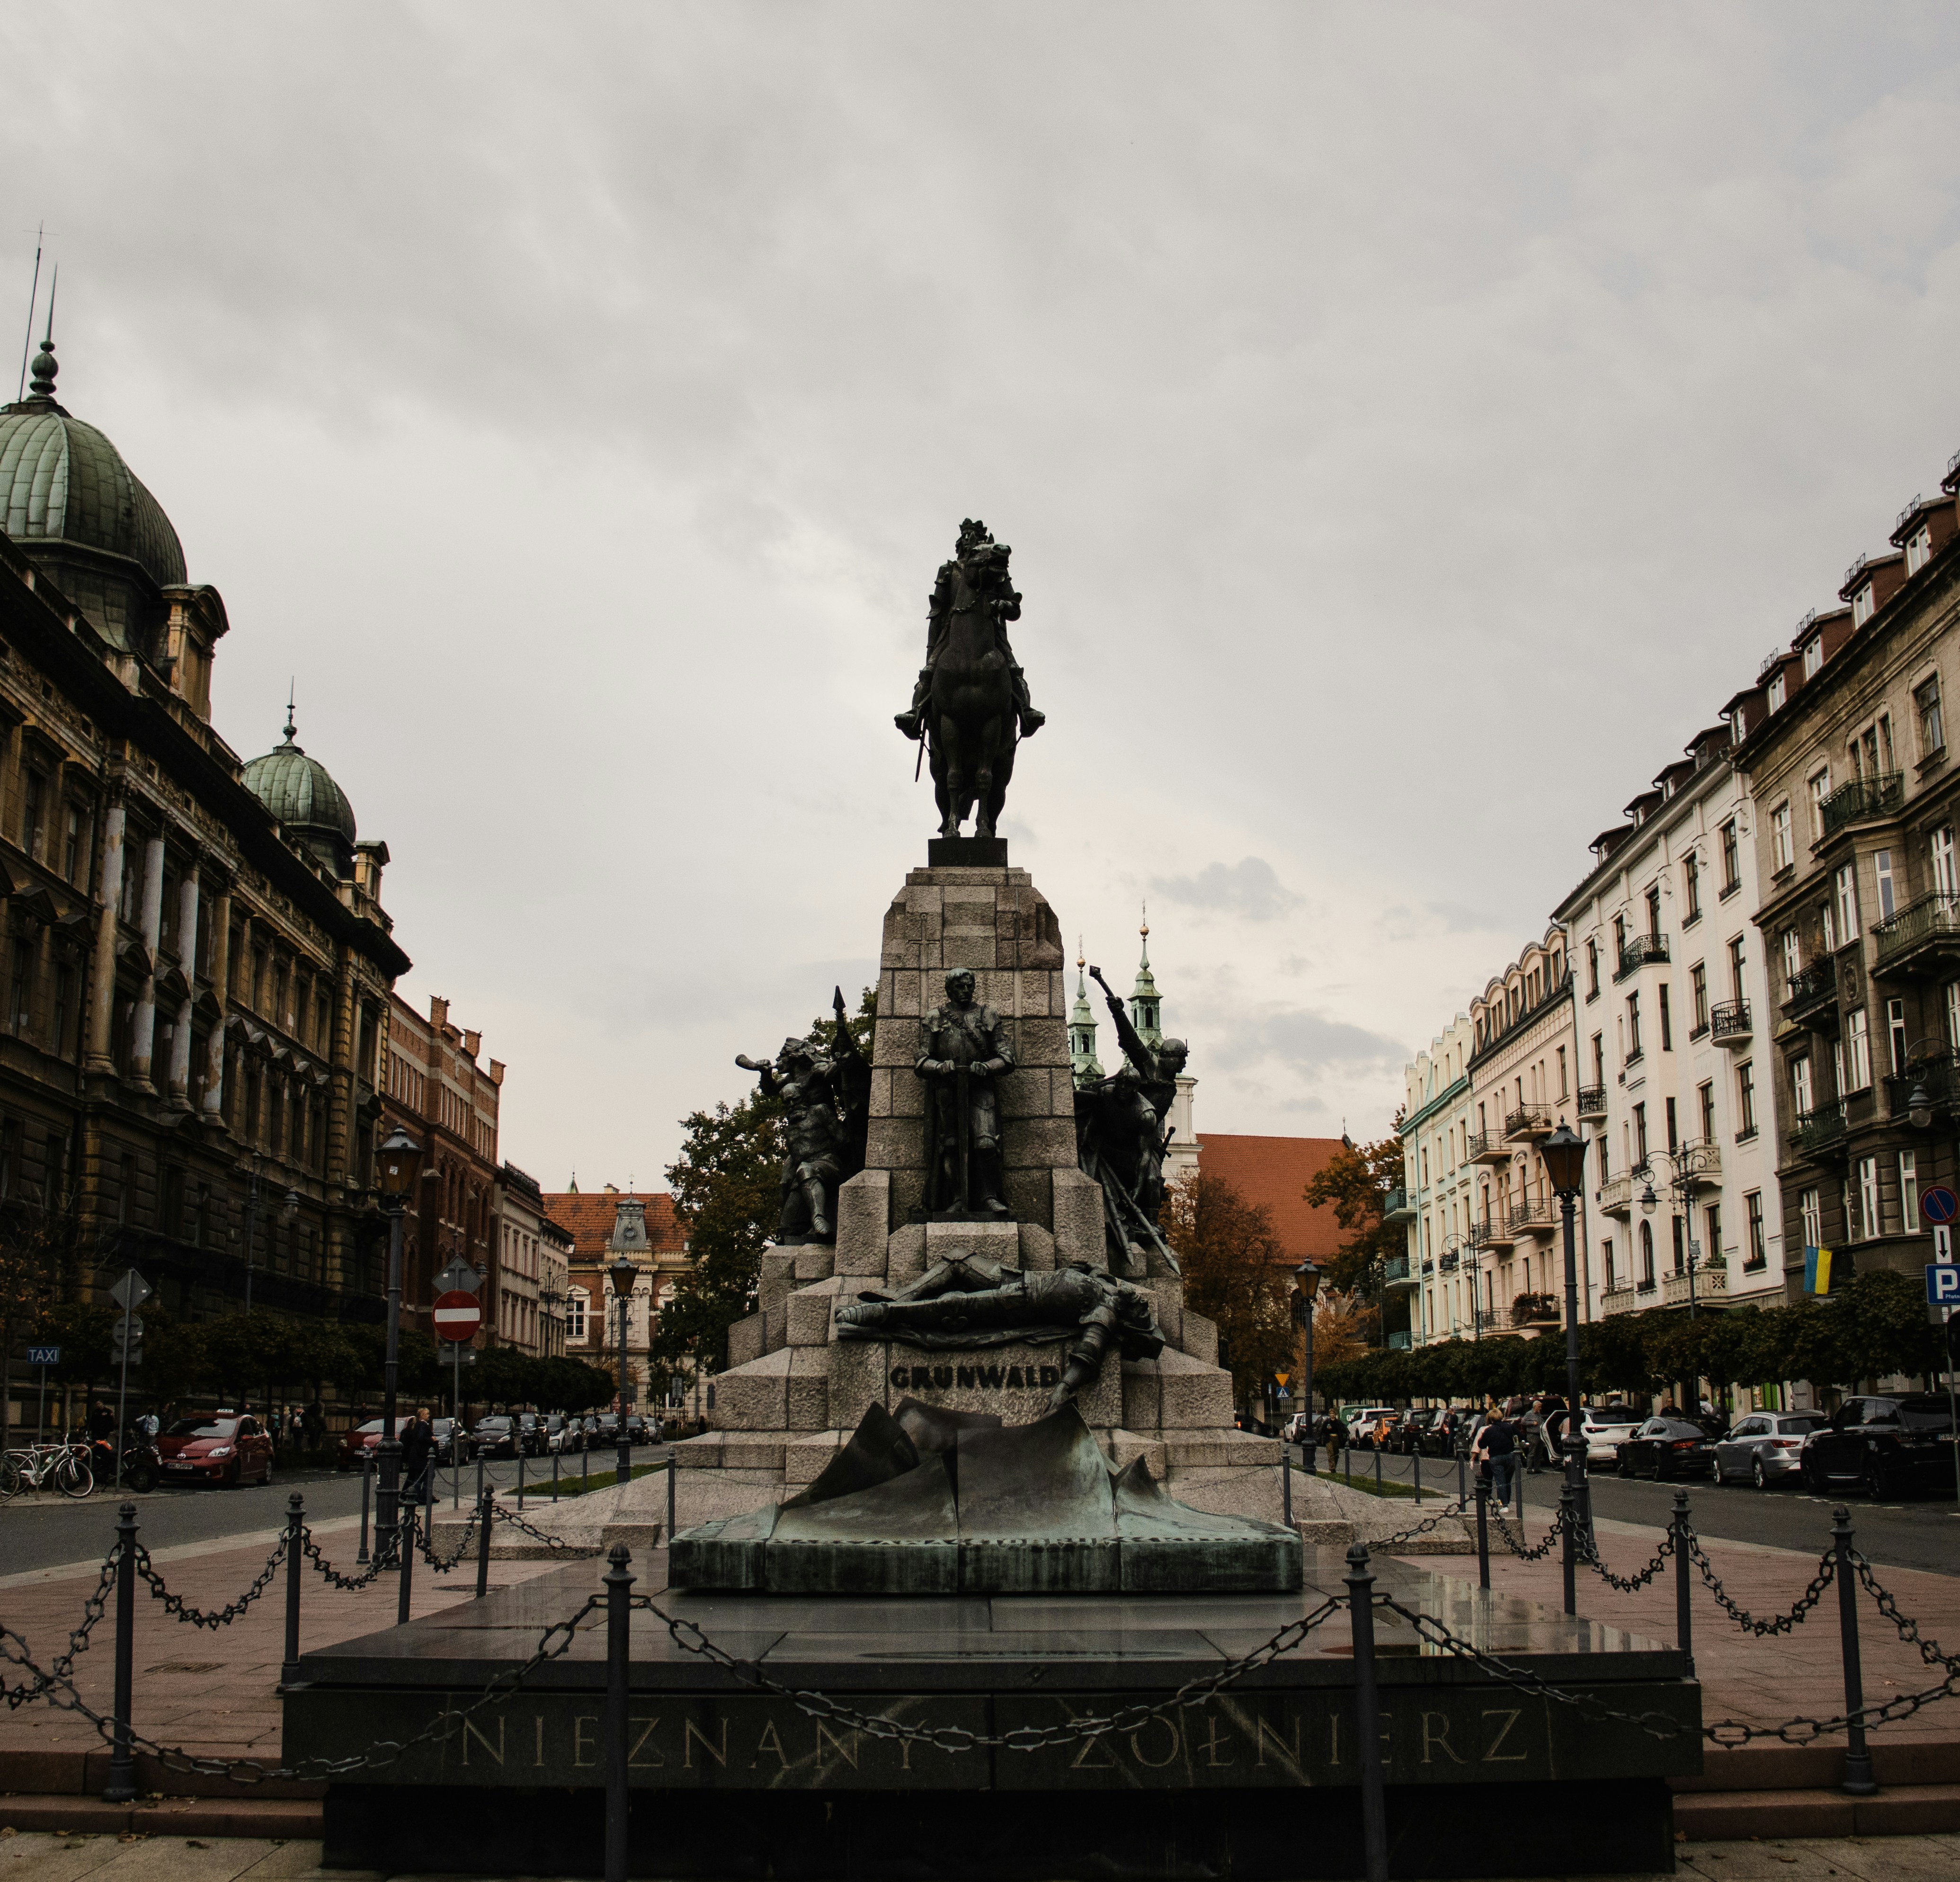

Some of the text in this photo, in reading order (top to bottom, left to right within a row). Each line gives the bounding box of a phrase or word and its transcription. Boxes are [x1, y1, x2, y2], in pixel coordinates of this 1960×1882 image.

[1935, 1269, 1958, 1300] P
[28, 1349, 57, 1362] TAXI
[891, 1366, 1060, 1388] GRUNWALD
[461, 1715, 927, 1770] NIEZNANY
